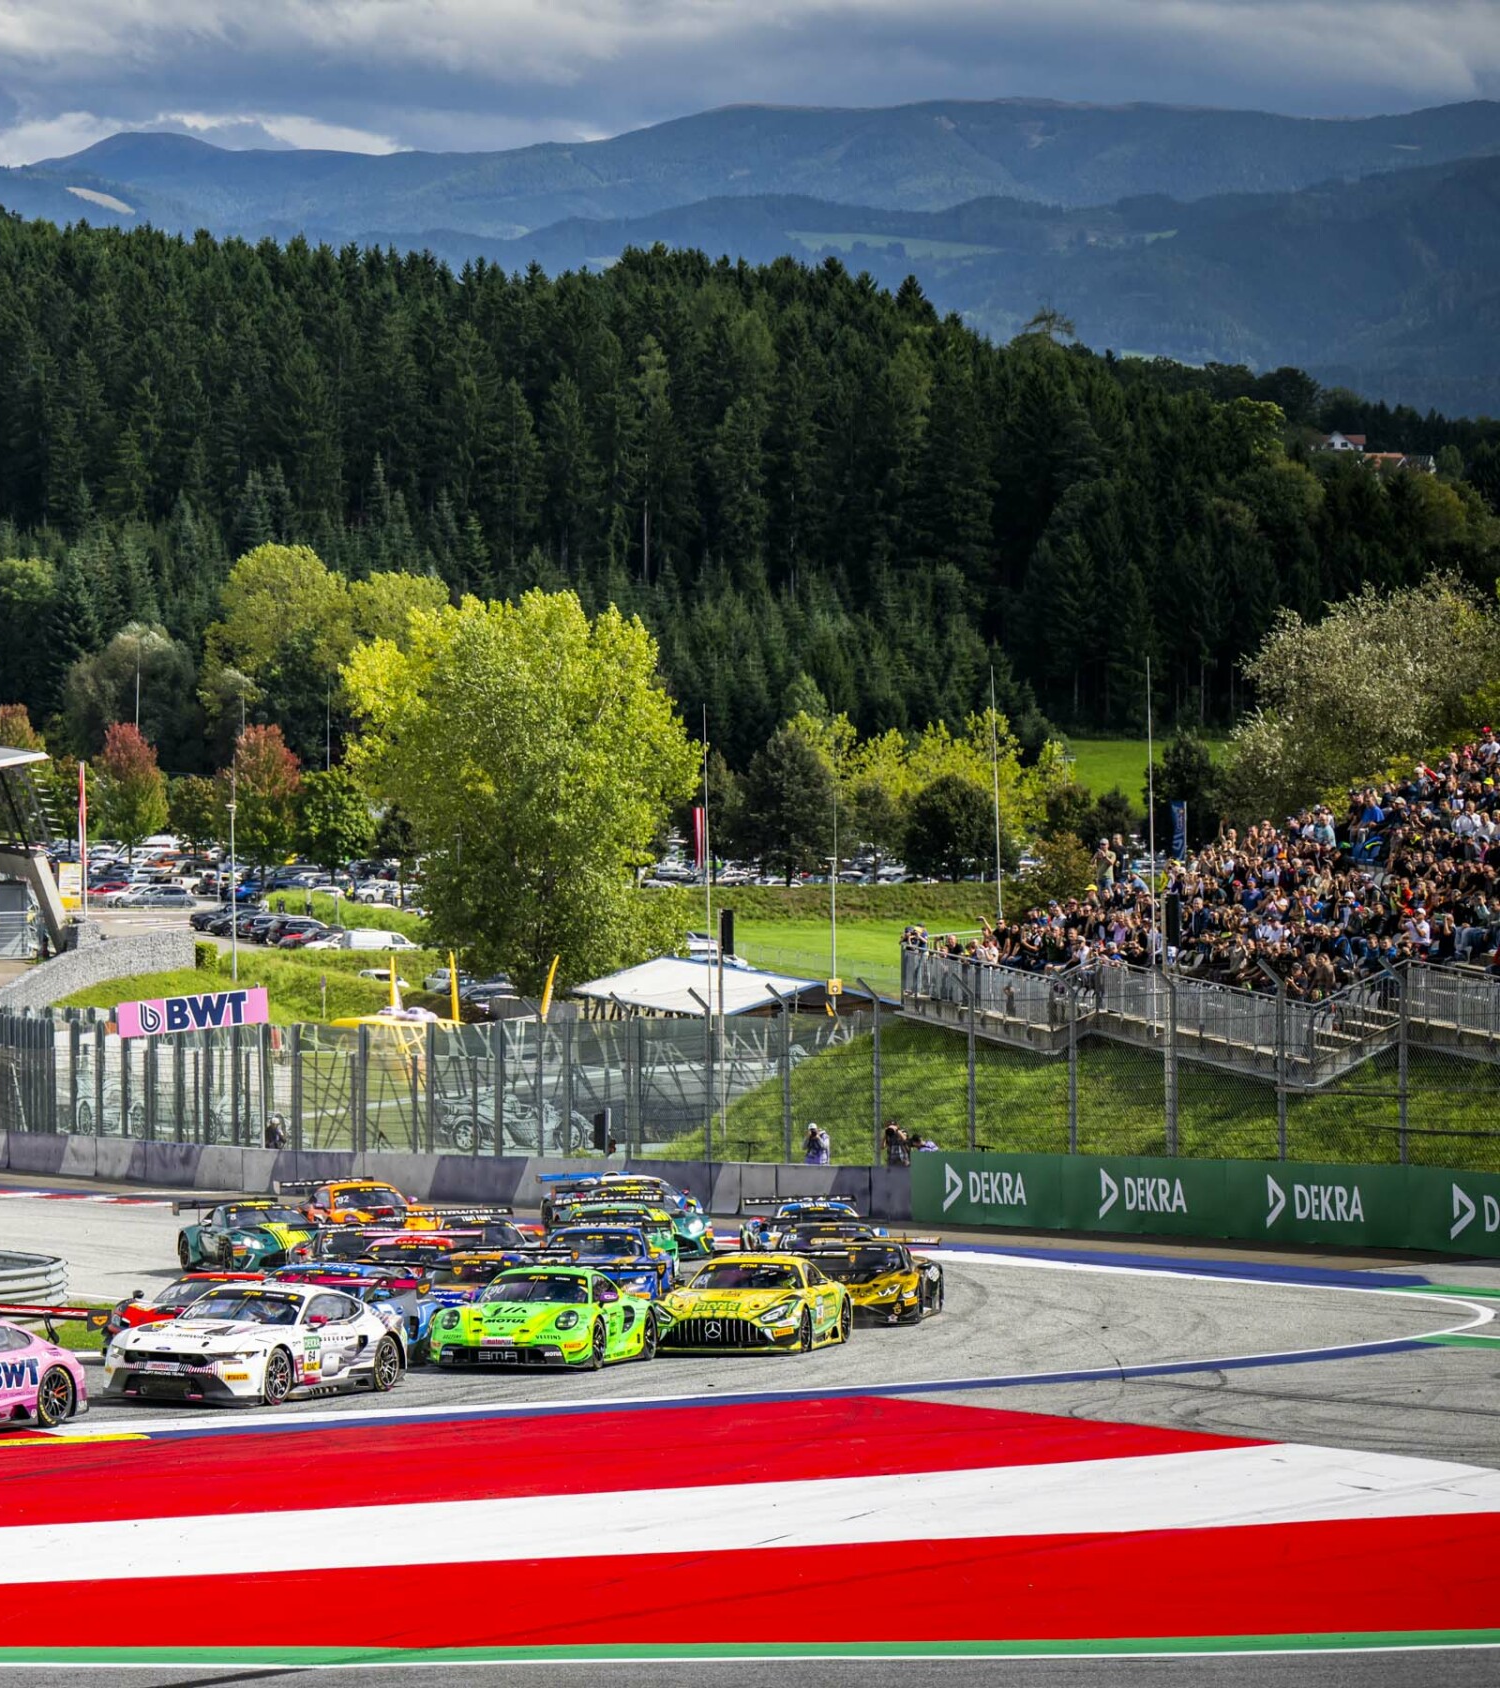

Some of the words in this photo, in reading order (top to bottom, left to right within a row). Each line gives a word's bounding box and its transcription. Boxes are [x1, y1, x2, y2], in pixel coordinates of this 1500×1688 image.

[166, 992, 247, 1032] BWT
[969, 1172, 1026, 1205] DEKRA
[1125, 1177, 1187, 1213] DEKRA
[1294, 1184, 1363, 1222] DEKRA
[307, 1350, 316, 1362] 64
